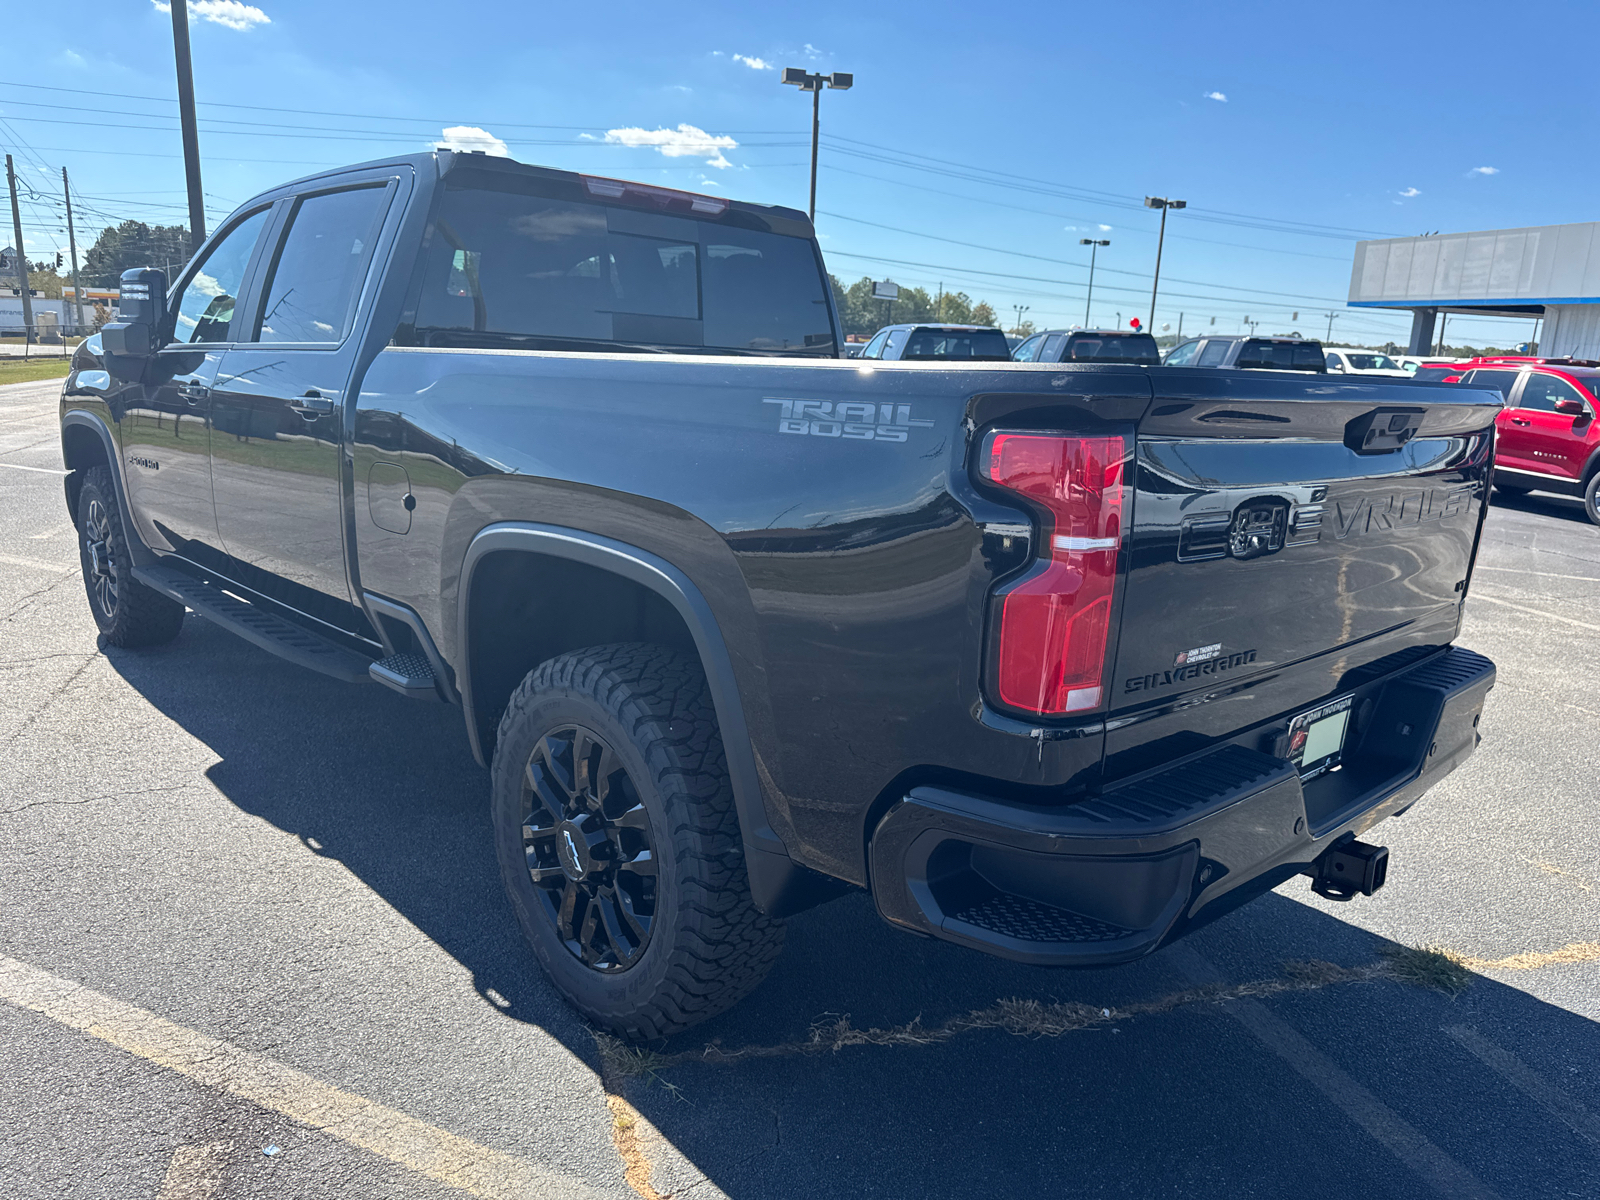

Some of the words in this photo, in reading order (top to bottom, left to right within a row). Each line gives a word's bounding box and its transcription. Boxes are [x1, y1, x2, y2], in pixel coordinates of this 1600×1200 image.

[762, 396, 935, 428] TRAIL
[779, 418, 909, 442] BOSS
[1177, 481, 1479, 562] CHEVROLET
[1124, 649, 1257, 694] SILVERADO
[1186, 652, 1213, 663] CHEVROLET
